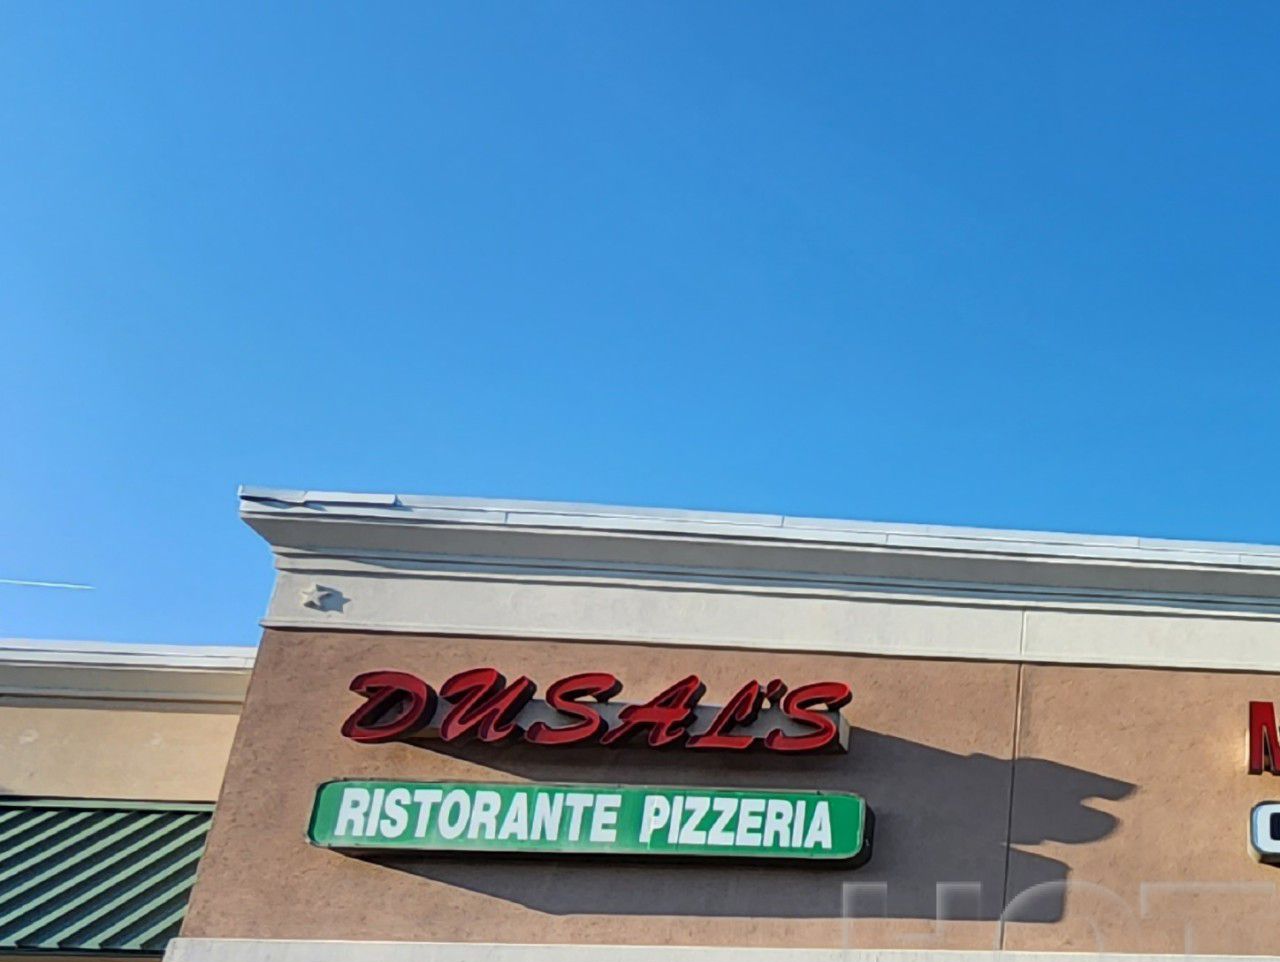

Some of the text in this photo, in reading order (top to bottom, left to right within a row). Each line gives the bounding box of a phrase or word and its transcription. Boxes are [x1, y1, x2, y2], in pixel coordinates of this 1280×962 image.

[340, 668, 852, 752] DUSAL'S
[334, 787, 833, 850] RISTORANTE PIZZERIA
